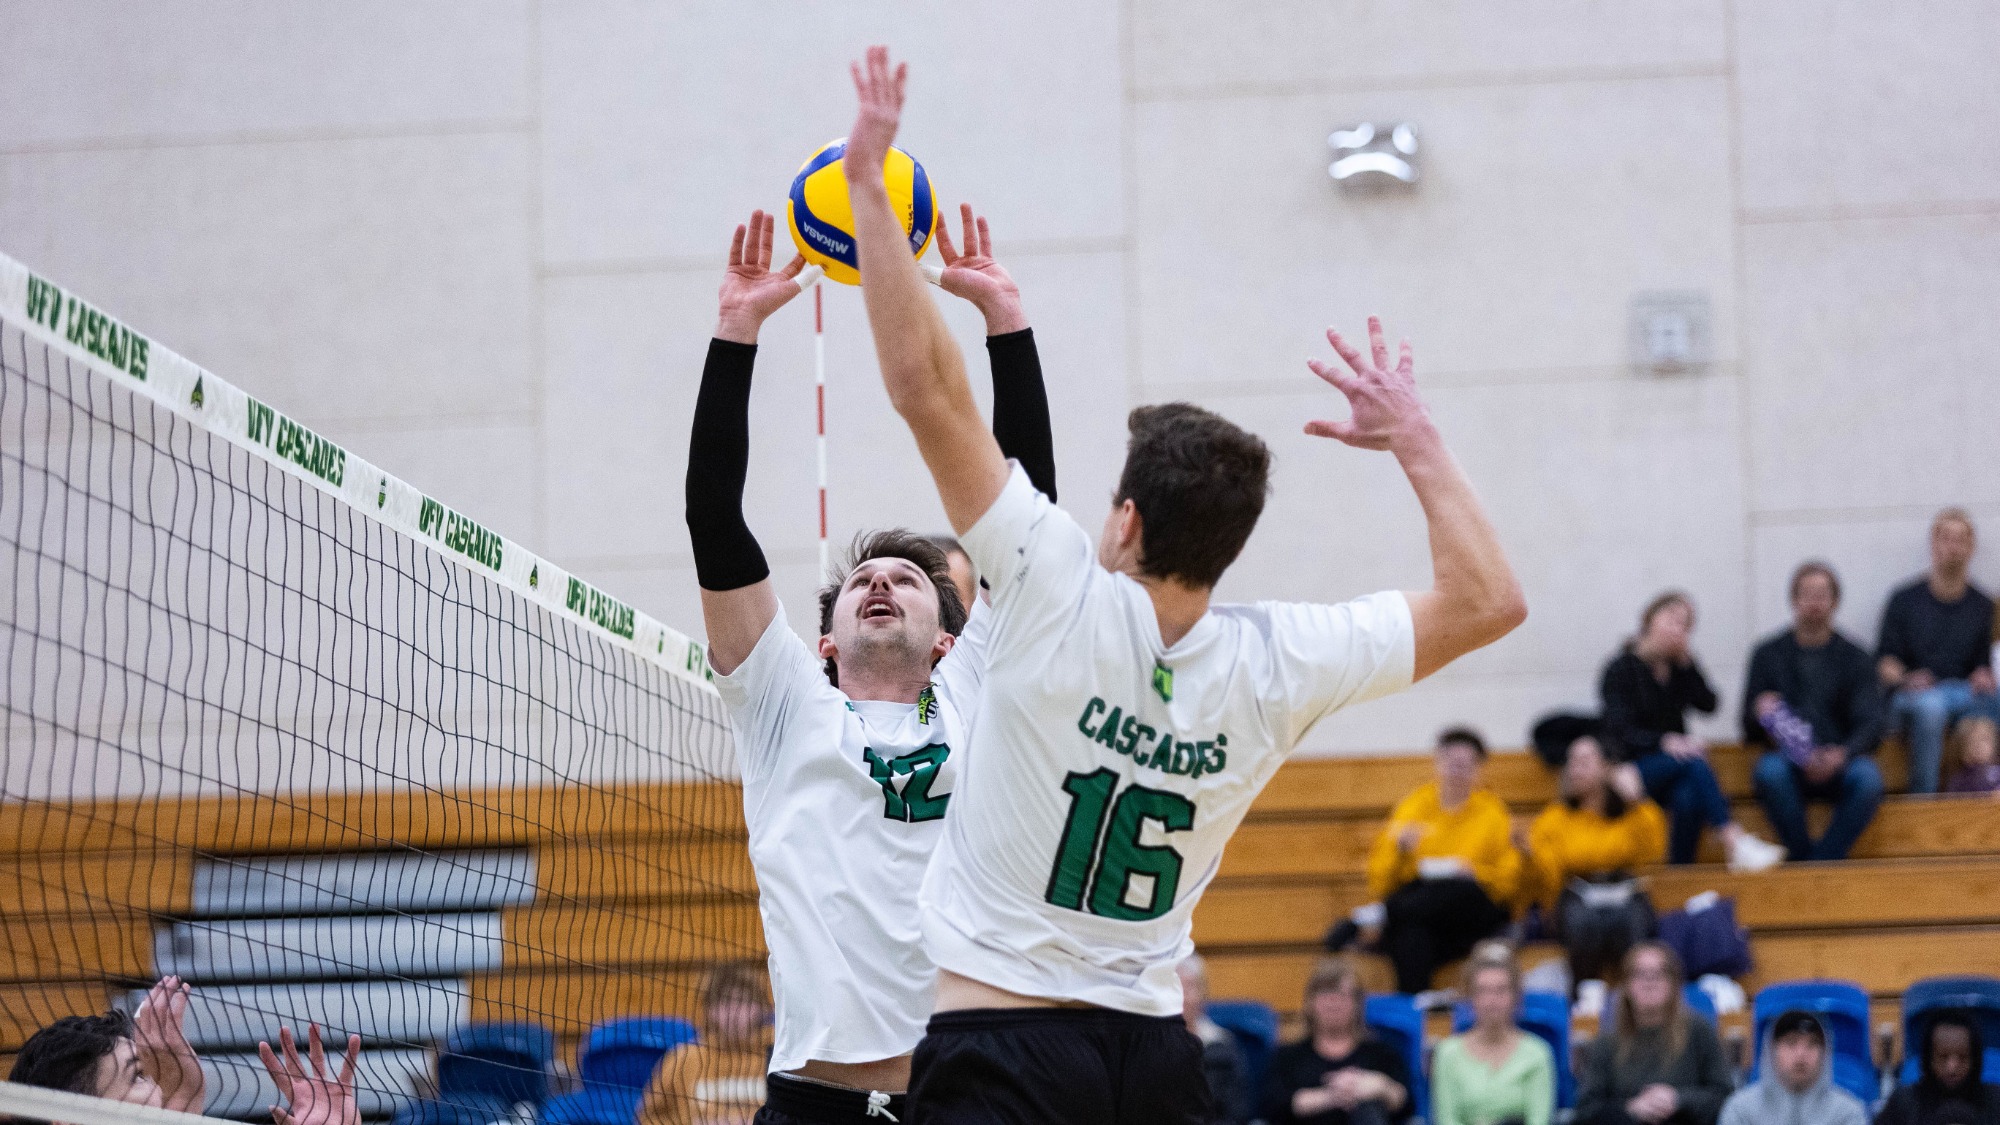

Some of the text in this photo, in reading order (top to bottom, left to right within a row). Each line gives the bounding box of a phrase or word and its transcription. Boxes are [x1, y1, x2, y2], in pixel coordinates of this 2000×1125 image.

[27, 271, 149, 382] UFV CASCADES
[247, 396, 346, 488] UFV CASCADES
[419, 495, 503, 572] UFV CASCADES
[1078, 696, 1228, 780] CASCADES
[863, 742, 952, 823] 12
[1045, 766, 1197, 922] 16
